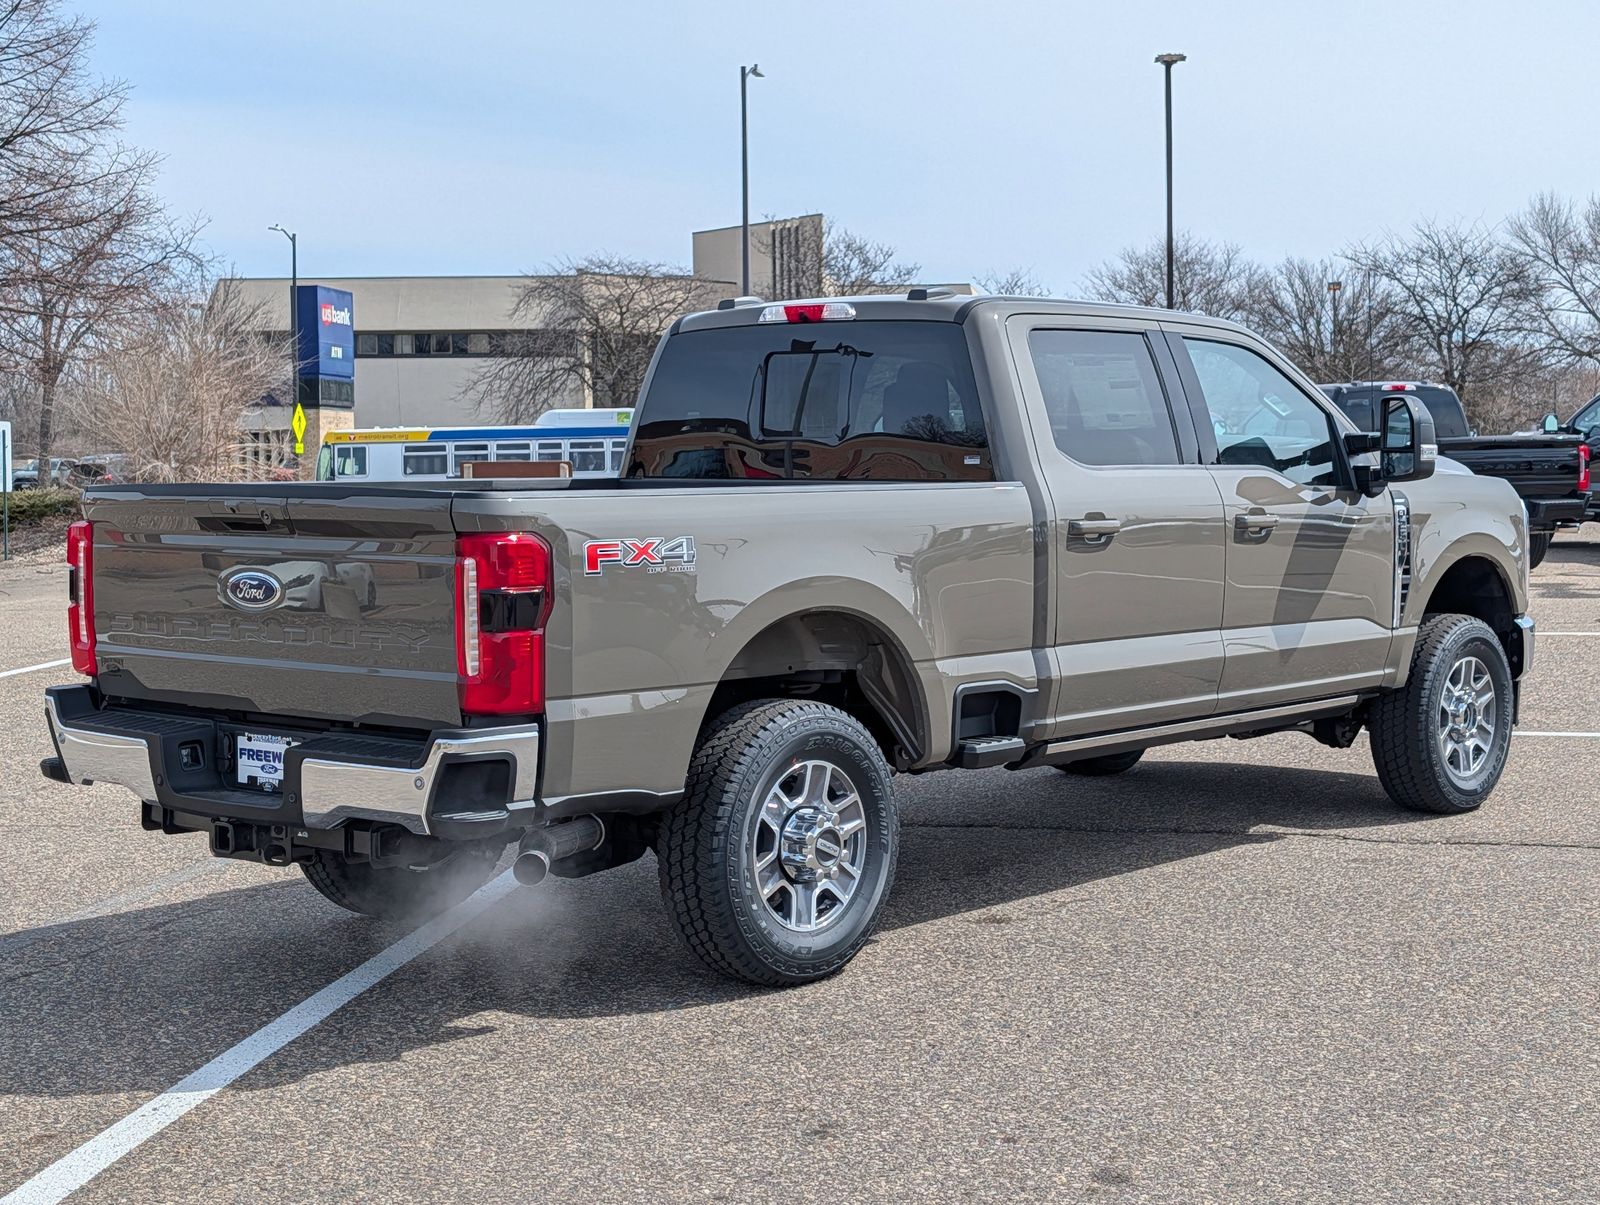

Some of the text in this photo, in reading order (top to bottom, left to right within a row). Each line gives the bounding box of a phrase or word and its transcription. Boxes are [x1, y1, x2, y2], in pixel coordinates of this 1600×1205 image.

[358, 432, 409, 441] metrotransit.org
[583, 536, 696, 577] FX4
[236, 579, 266, 600] Ford
[110, 612, 432, 654] SUPER DUTY
